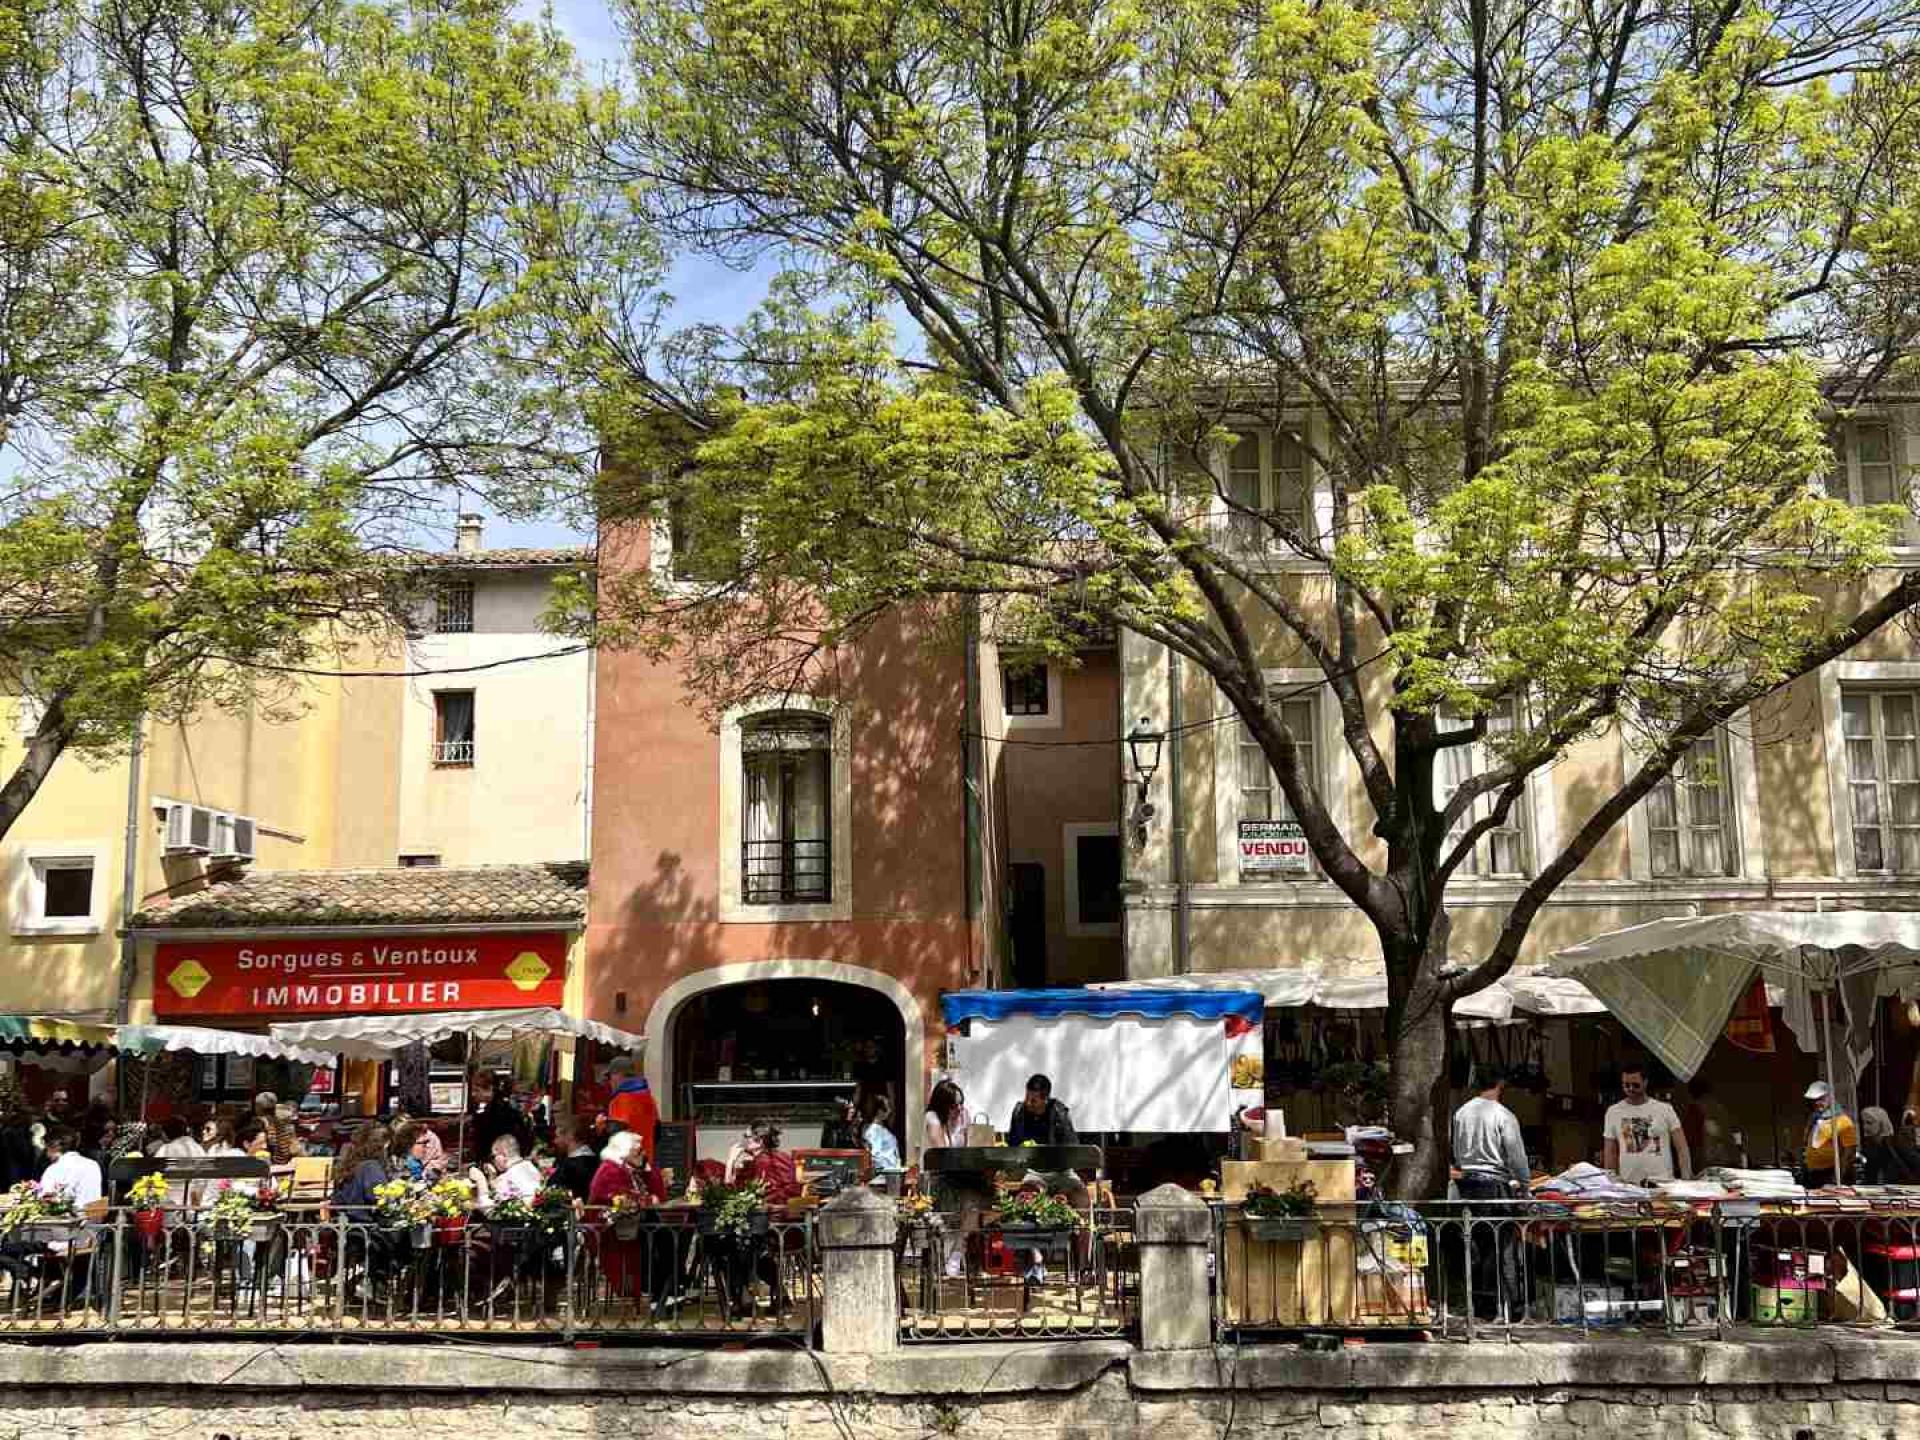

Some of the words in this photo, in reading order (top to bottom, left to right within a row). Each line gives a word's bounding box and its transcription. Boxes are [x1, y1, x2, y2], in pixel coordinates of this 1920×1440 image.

[1241, 842, 1306, 856] VENDU
[237, 949, 344, 974] Sorgues
[351, 951, 365, 967] &
[372, 946, 478, 967] Ventoux
[252, 981, 461, 1007] IMMOBILIER
